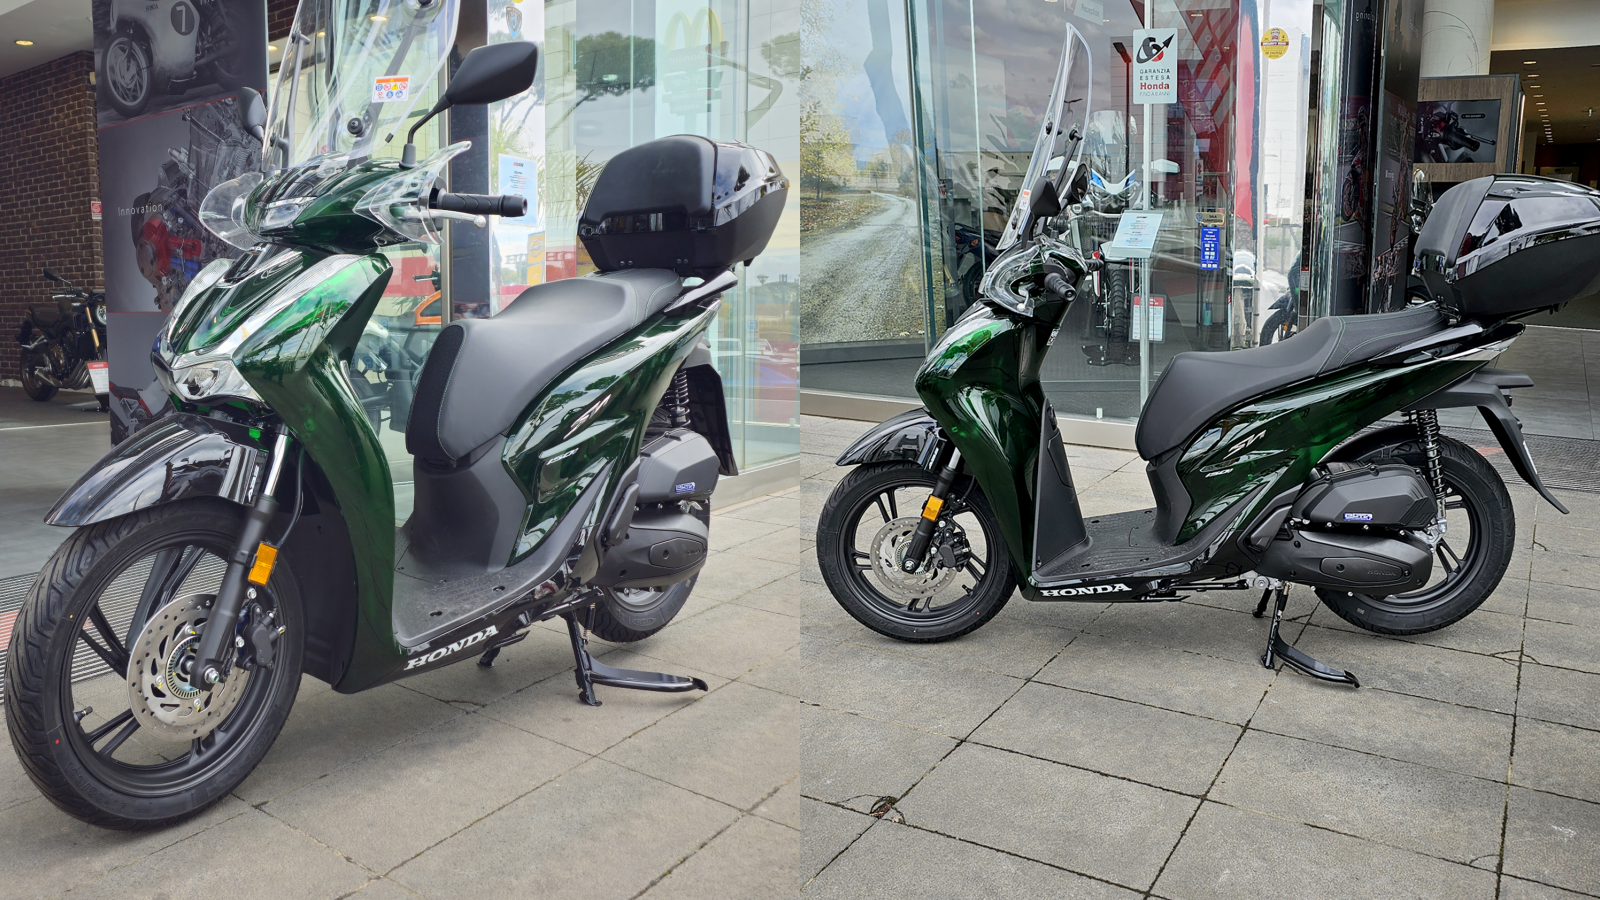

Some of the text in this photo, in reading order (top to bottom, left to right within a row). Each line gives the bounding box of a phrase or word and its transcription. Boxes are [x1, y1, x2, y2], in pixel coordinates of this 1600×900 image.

[175, 4, 186, 33] 7
[1140, 82, 1170, 90] Honda
[117, 203, 163, 217] Innovation
[1039, 582, 1133, 597] HONDA
[402, 624, 500, 671] HONDA
